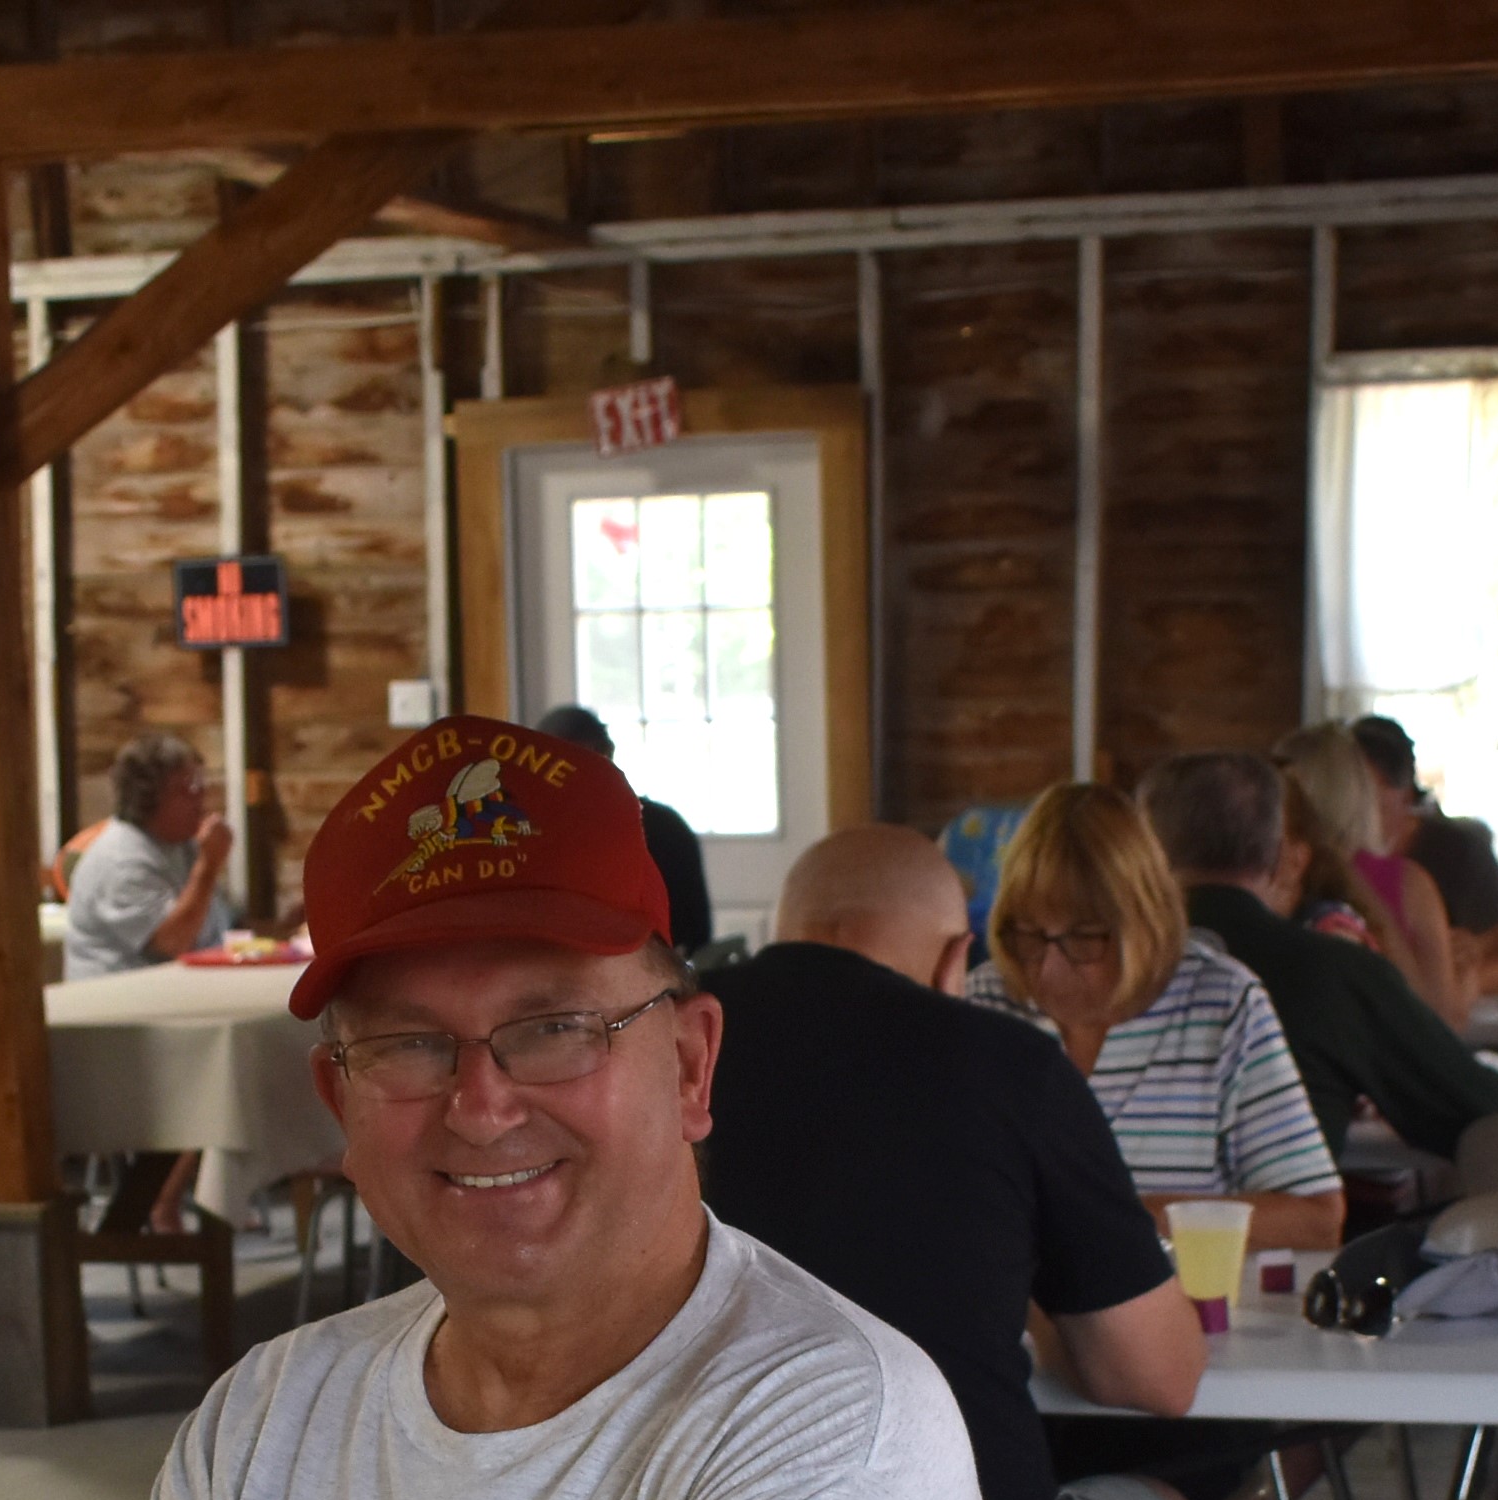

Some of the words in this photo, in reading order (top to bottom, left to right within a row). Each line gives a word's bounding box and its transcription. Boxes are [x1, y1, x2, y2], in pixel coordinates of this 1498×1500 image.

[593, 381, 679, 456] EXIT
[182, 593, 280, 643] SMOKING
[357, 728, 578, 823] NMCB-ONE
